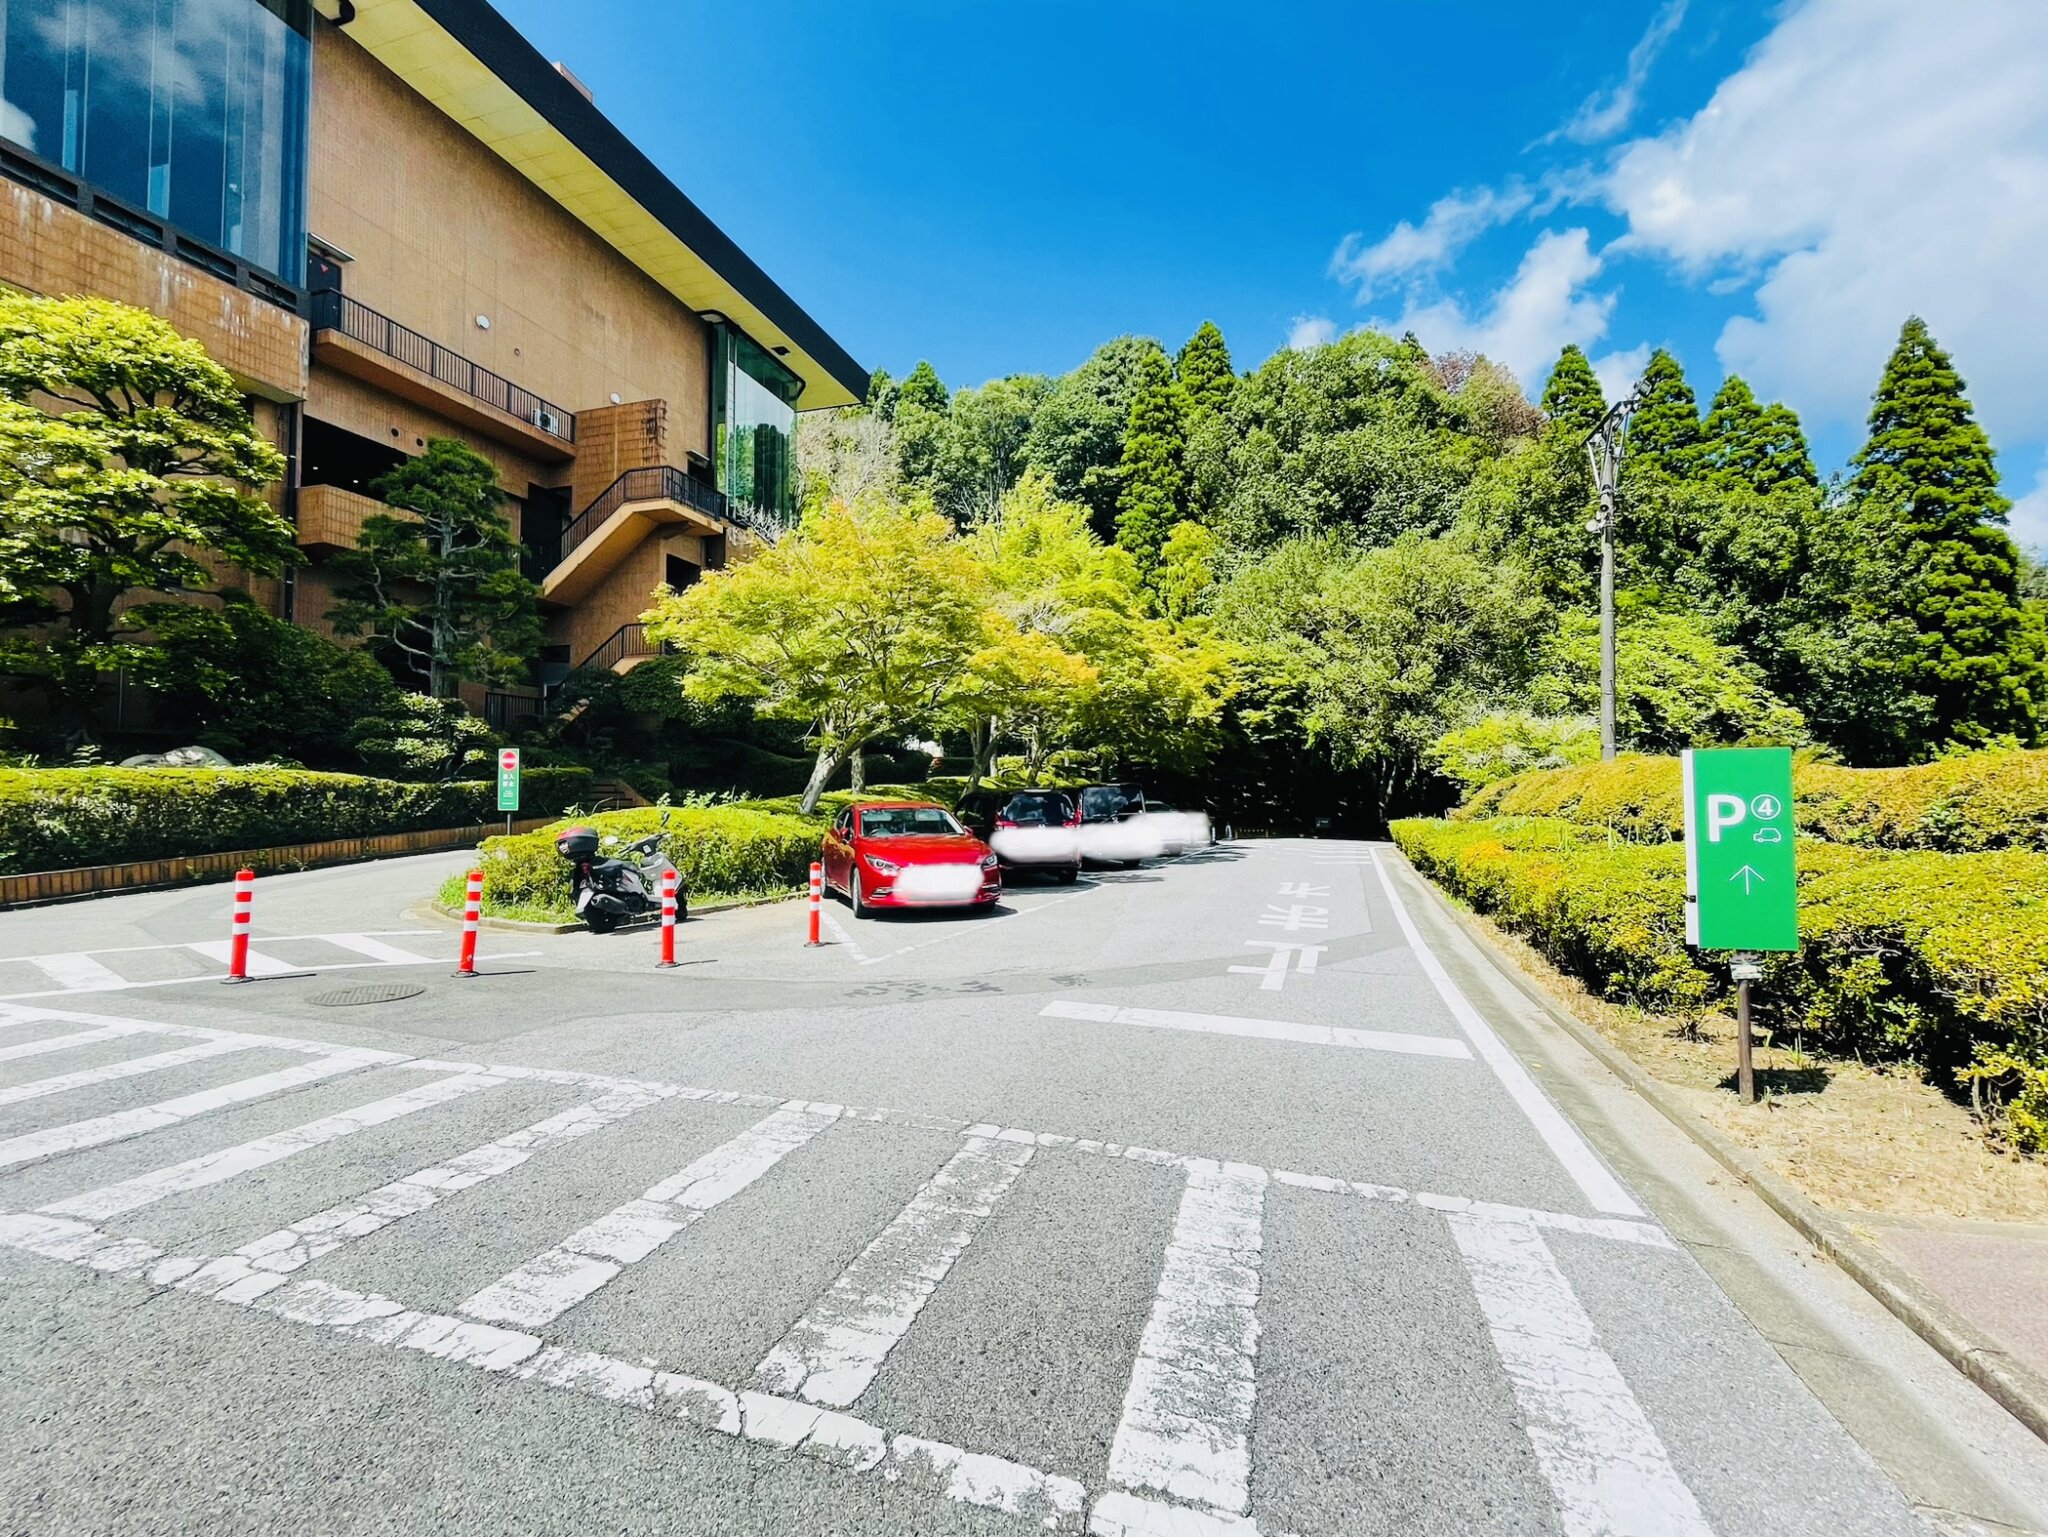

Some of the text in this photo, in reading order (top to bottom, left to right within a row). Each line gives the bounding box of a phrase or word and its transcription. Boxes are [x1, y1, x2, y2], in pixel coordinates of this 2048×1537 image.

[1708, 794, 1746, 842] P
[1227, 881, 1331, 991] 止まれ
